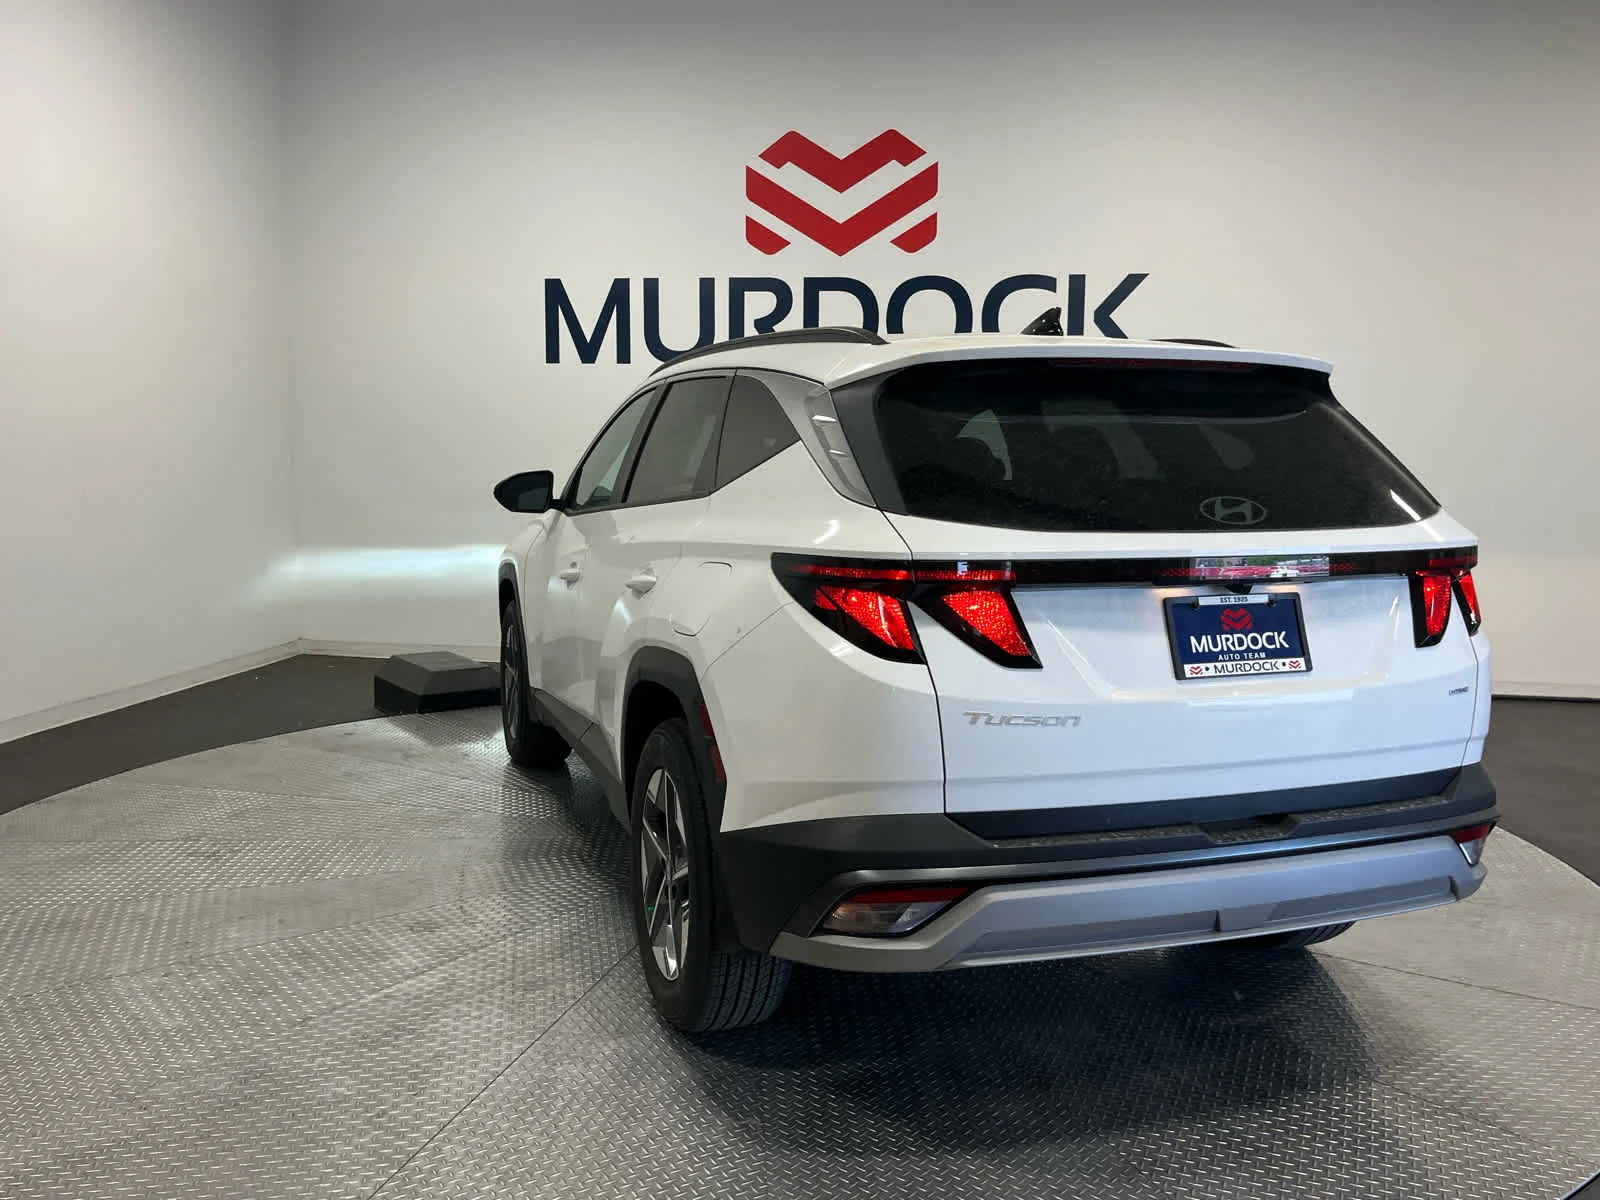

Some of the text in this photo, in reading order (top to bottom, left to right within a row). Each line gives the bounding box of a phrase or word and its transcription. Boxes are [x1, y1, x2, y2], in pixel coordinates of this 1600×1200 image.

[544, 273, 1150, 365] MURDOCK
[1190, 631, 1289, 654] MURDOCK
[1218, 652, 1266, 661] AUTO TEAM
[1213, 660, 1280, 674] MURDOCK
